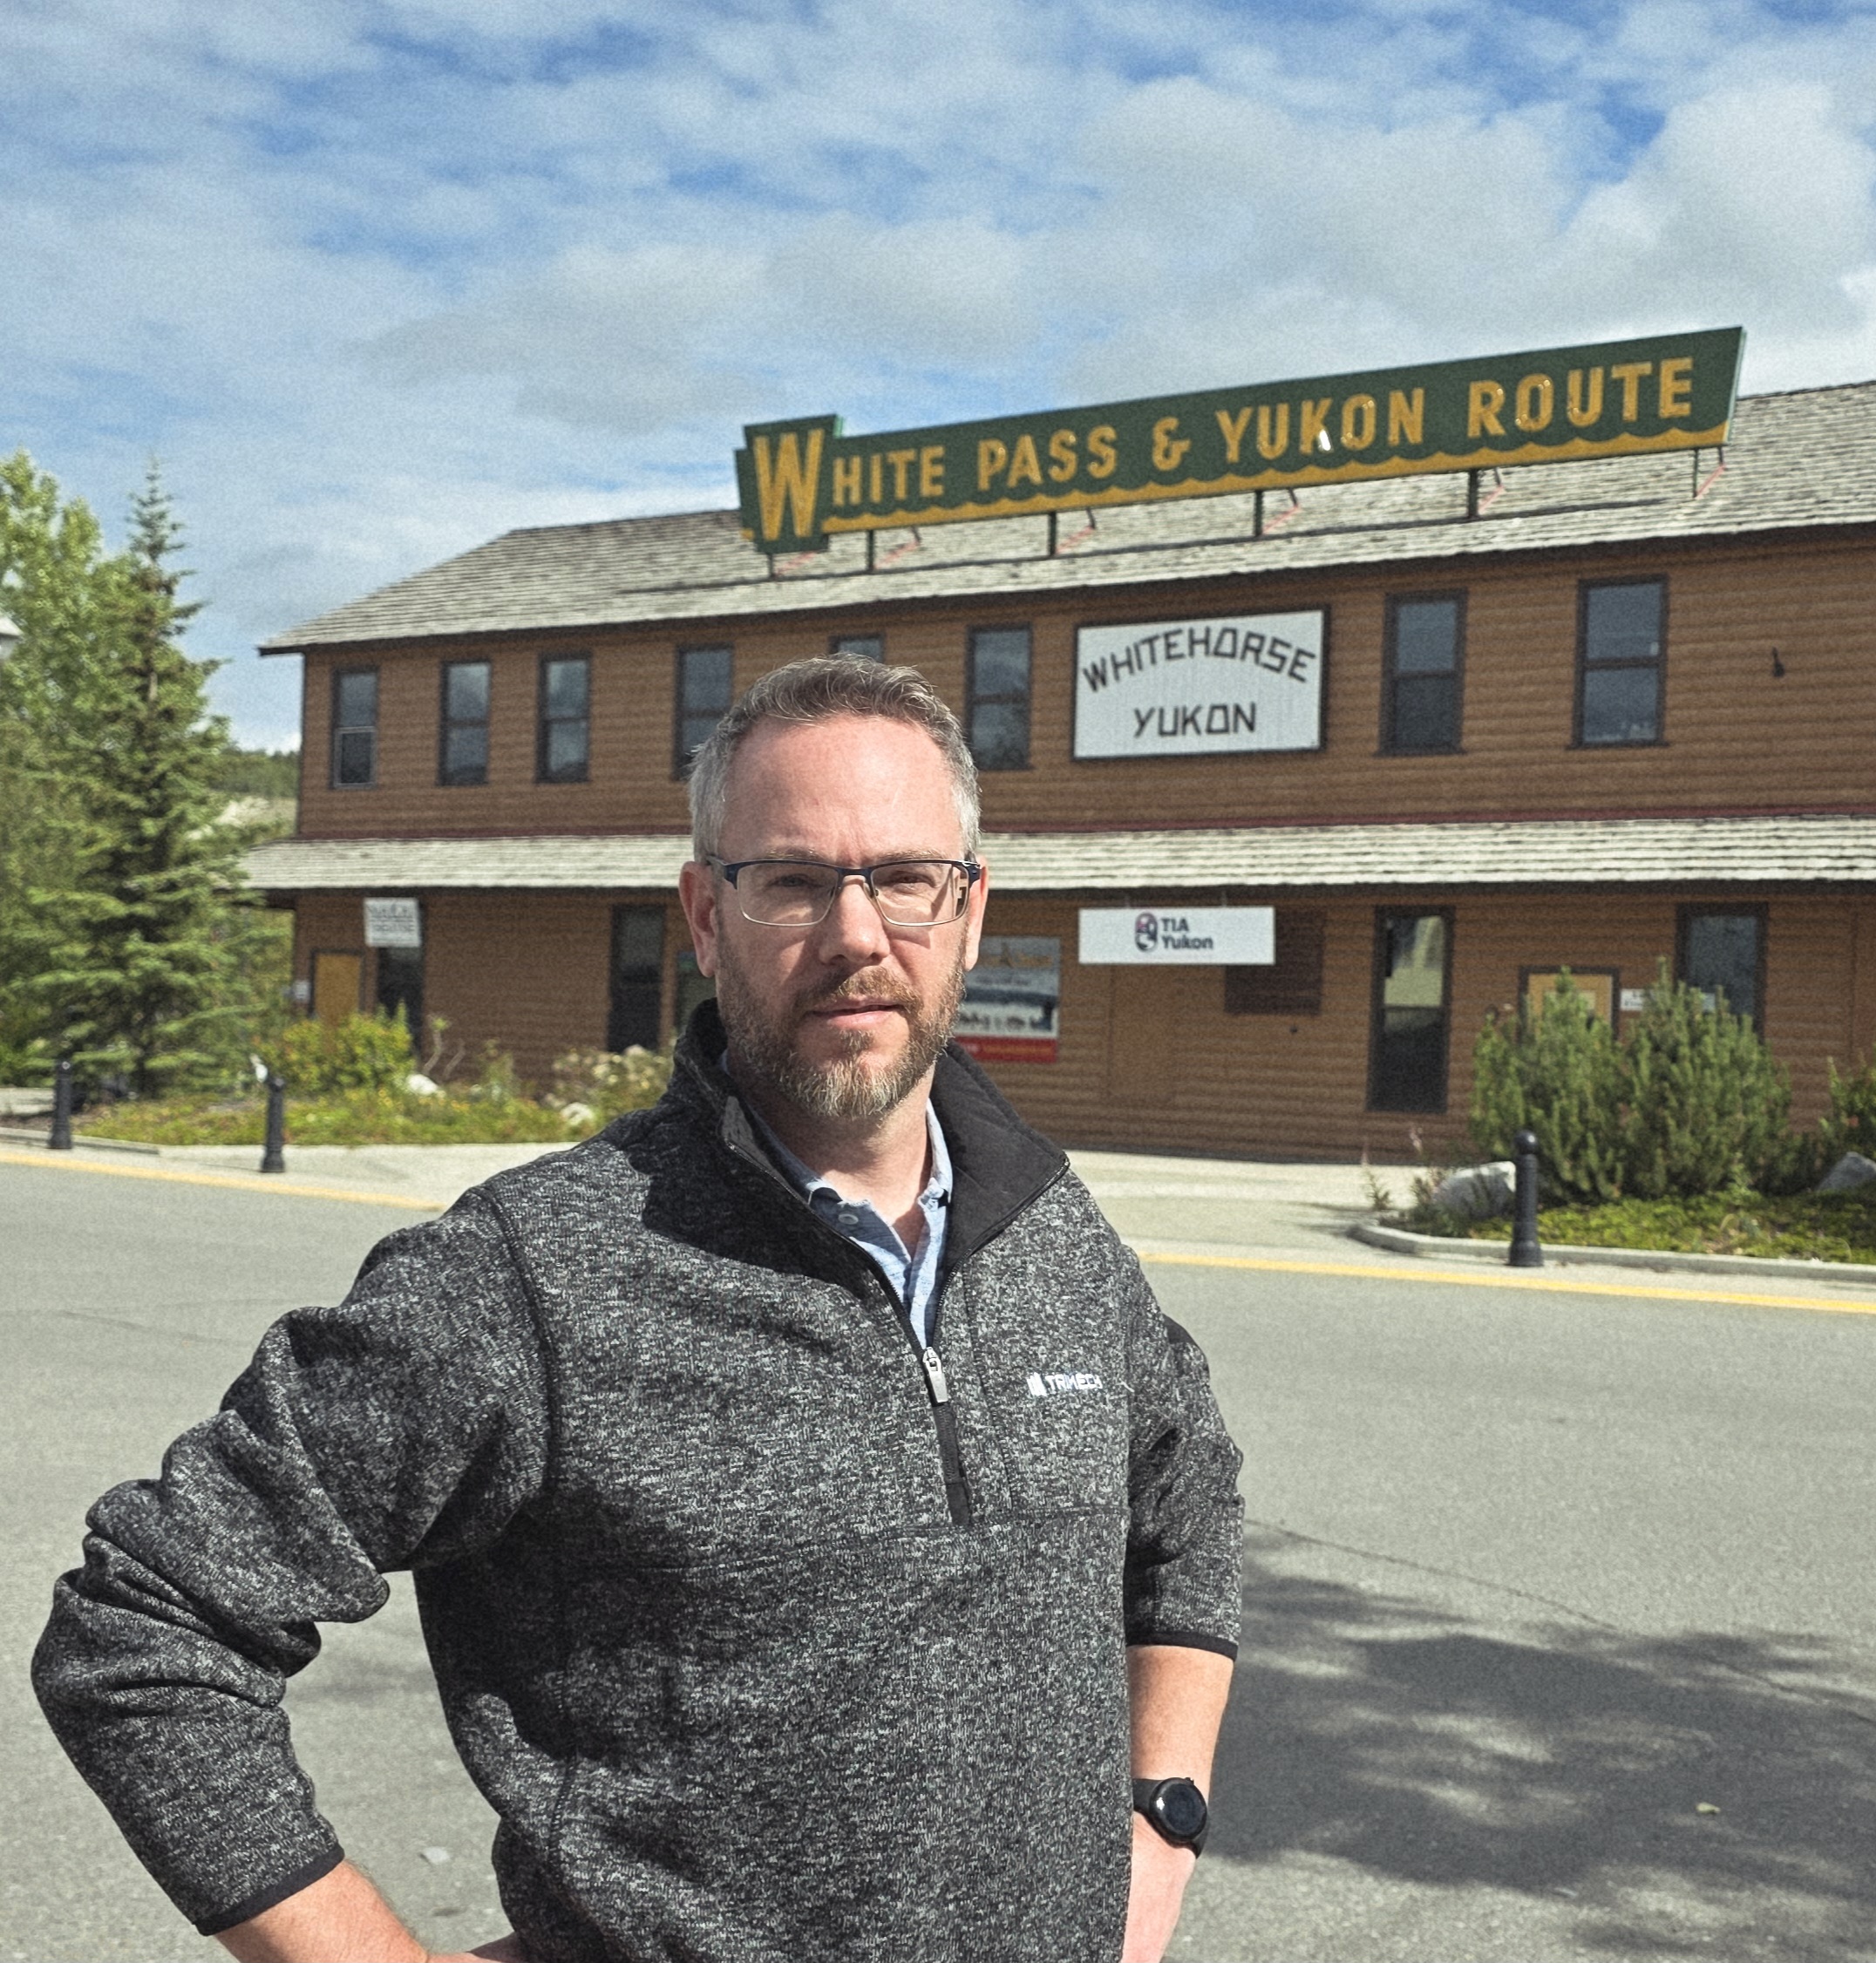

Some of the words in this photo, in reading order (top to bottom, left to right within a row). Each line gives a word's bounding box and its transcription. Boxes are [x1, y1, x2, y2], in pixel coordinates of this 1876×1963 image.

[754, 428, 944, 541] WHITE
[977, 426, 1118, 491] PASS
[1152, 417, 1191, 472] &
[1215, 388, 1425, 464] YUKON
[1467, 357, 1693, 438] ROUTE
[1082, 626, 1316, 692] WHITEHORSE
[1134, 701, 1256, 738] YUKON
[1161, 918, 1189, 932] TIA
[1162, 934, 1213, 950] Yukon
